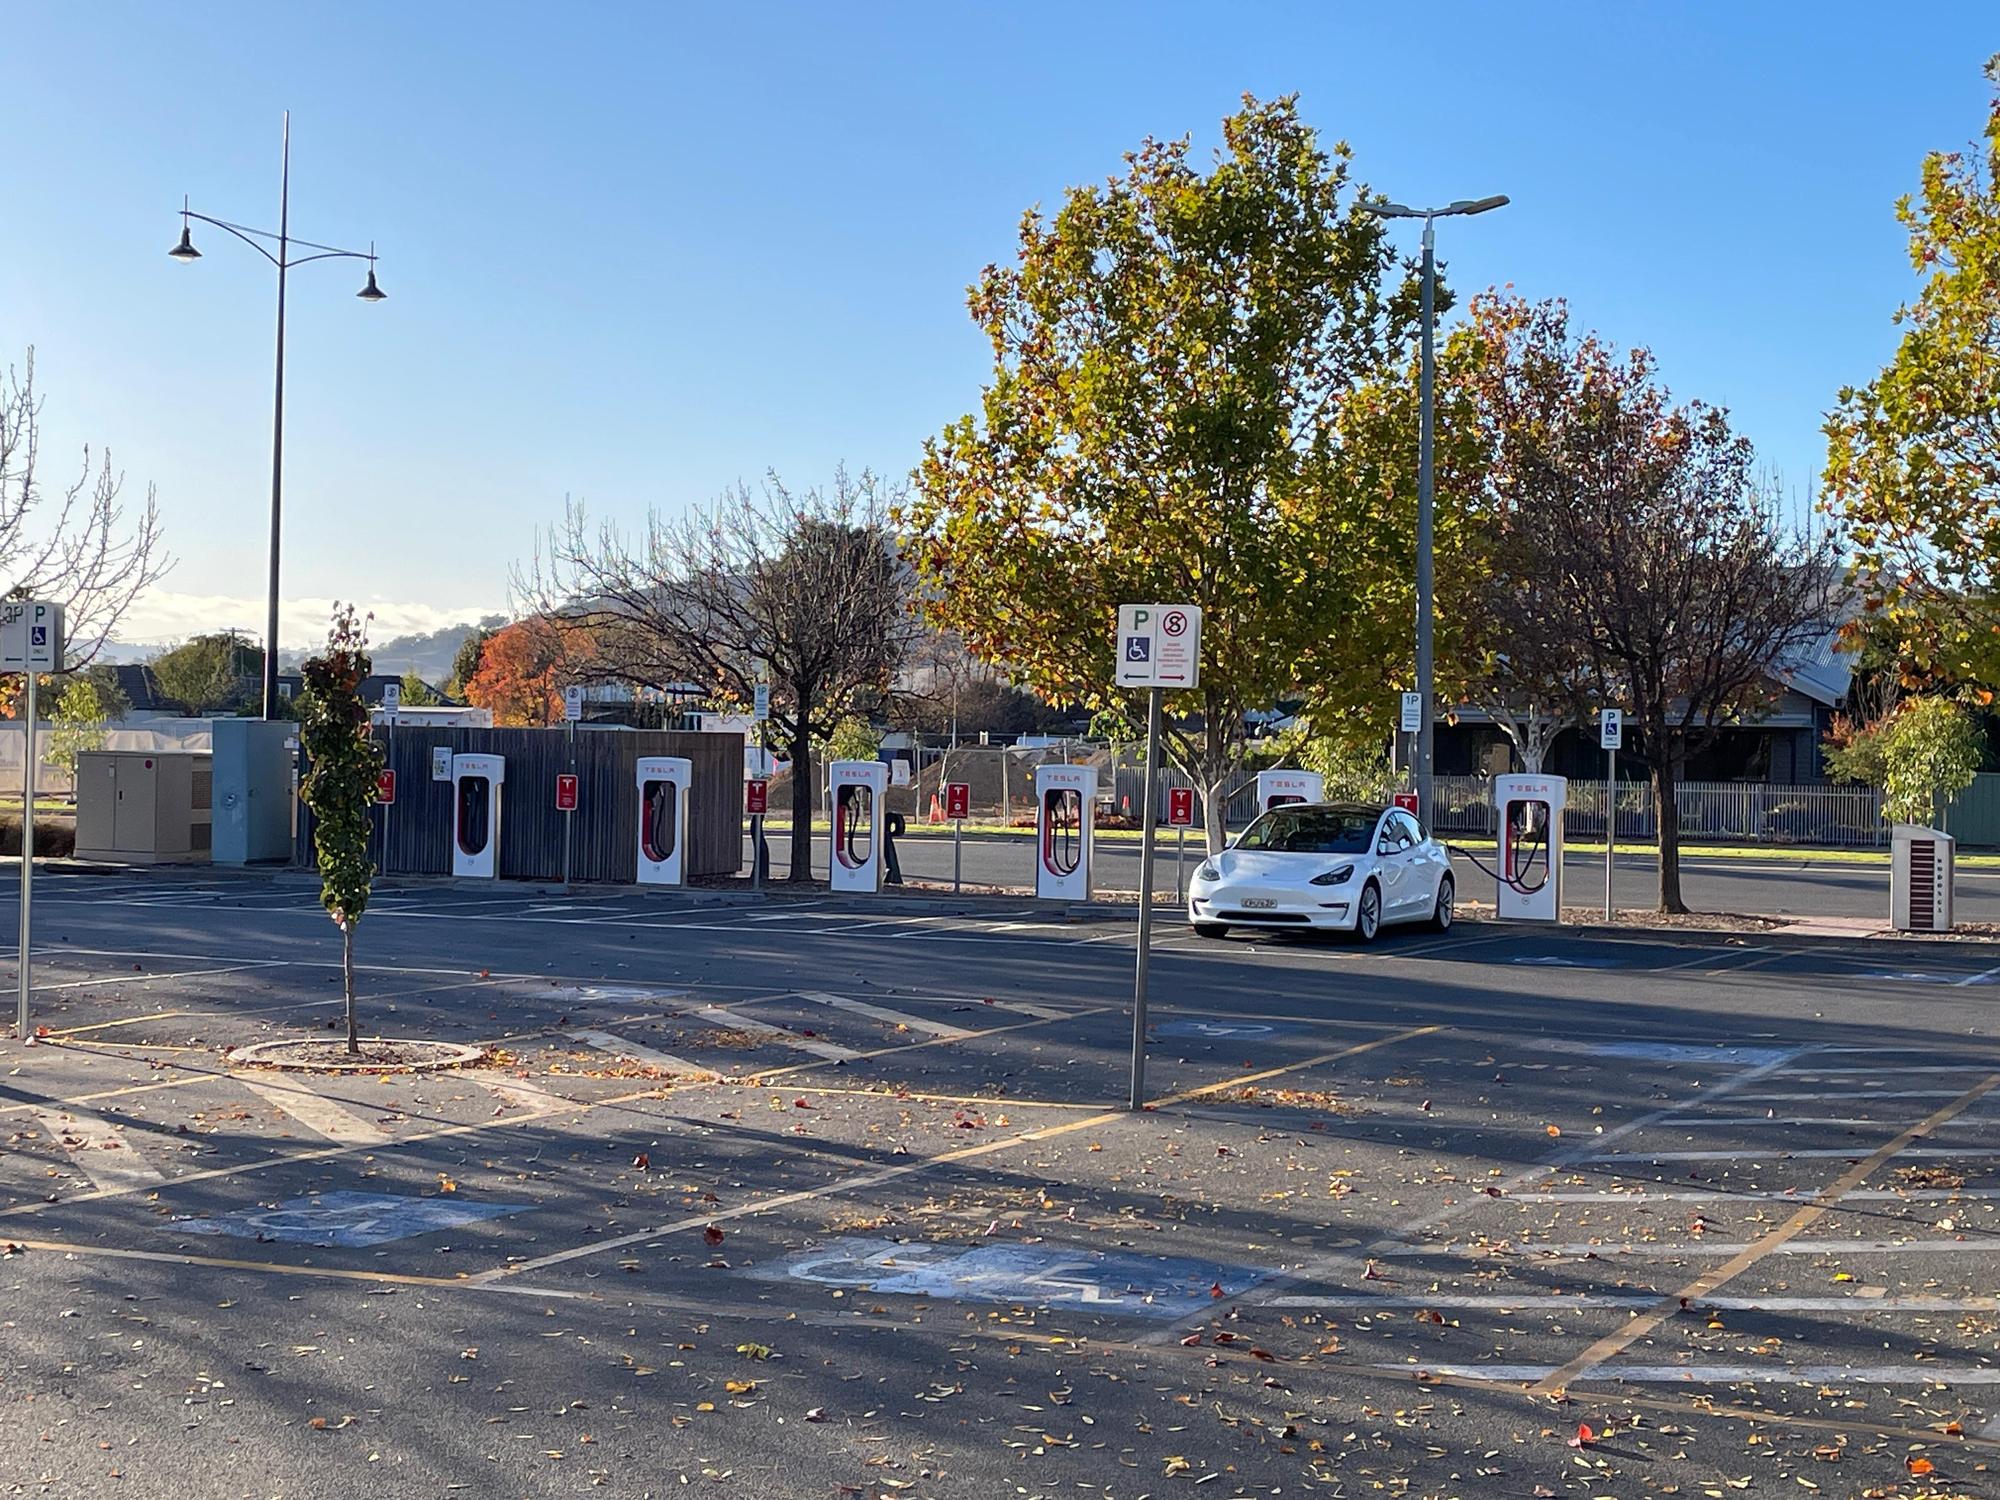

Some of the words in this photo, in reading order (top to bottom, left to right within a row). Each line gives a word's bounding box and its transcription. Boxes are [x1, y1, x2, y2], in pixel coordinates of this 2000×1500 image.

[35, 606, 46, 623] P
[1134, 610, 1149, 631] P
[1406, 695, 1419, 705] 1P
[1607, 711, 1616, 722] P
[840, 770, 872, 778] TESLA
[1046, 774, 1081, 782] TESLA
[1269, 780, 1306, 788] TESLA
[1509, 784, 1548, 792] TESLA
